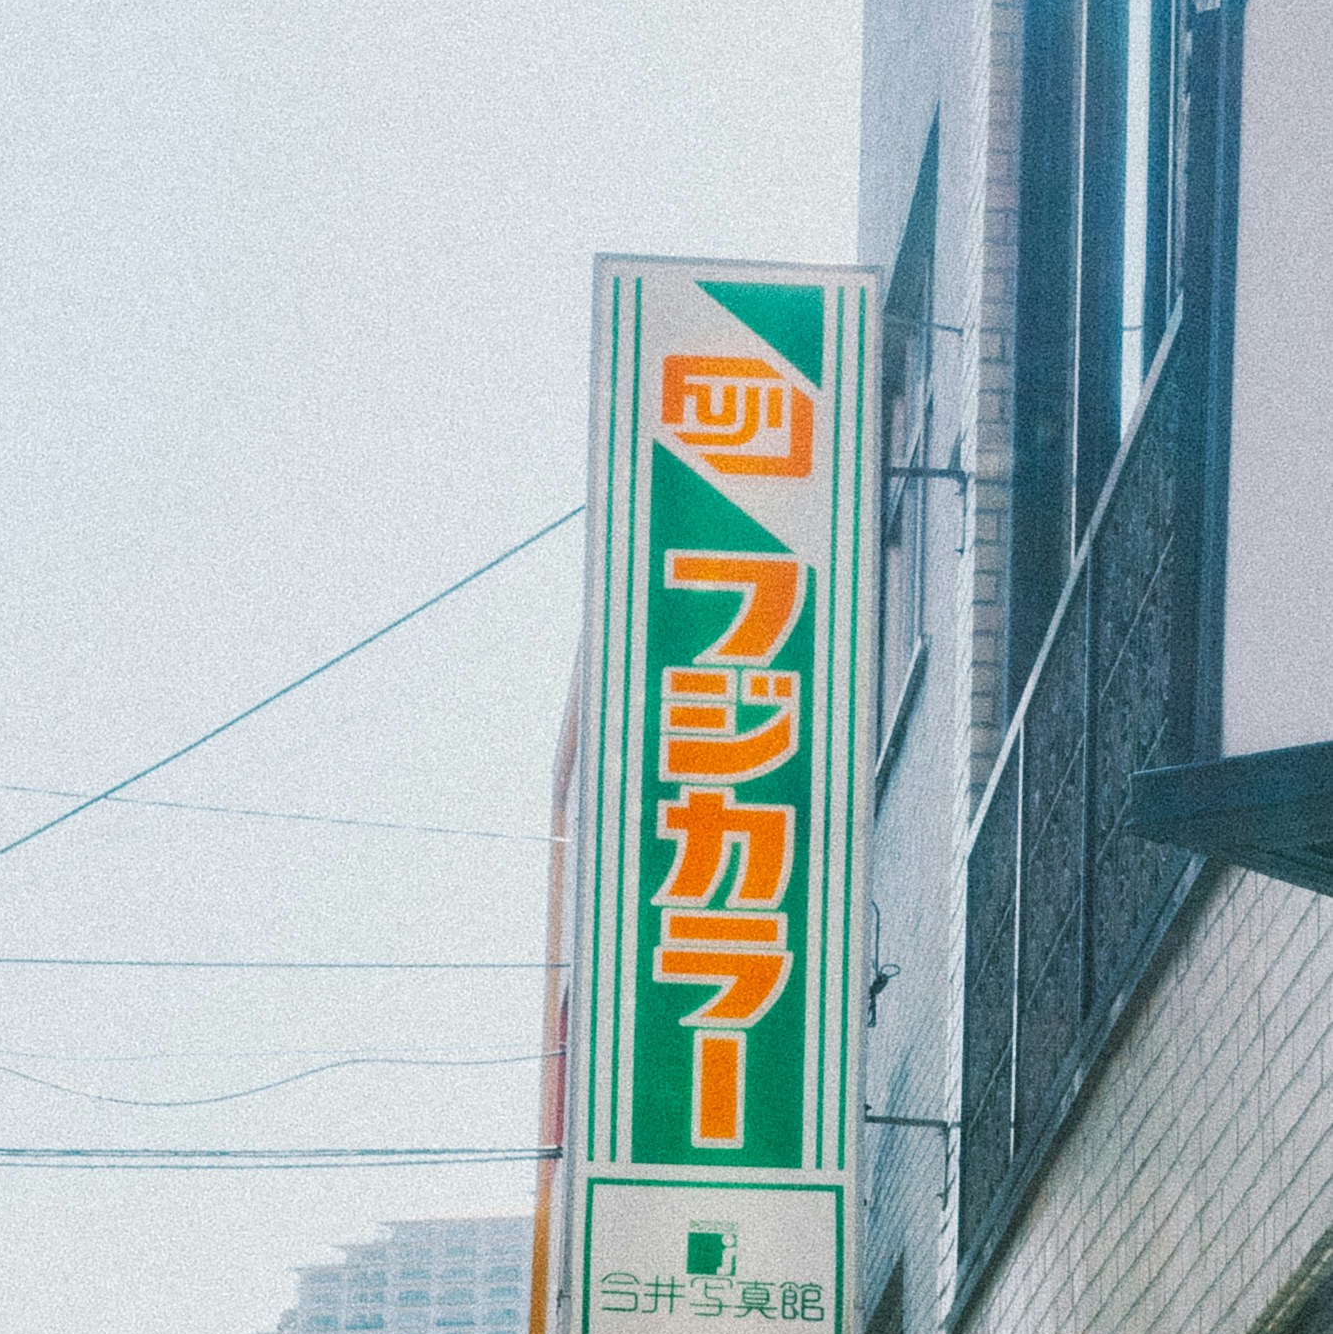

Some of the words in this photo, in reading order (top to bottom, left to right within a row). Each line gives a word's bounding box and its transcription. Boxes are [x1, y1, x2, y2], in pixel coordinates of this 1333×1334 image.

[654, 551, 805, 1145] フジカラー
[601, 1272, 825, 1322] 今井写真館
